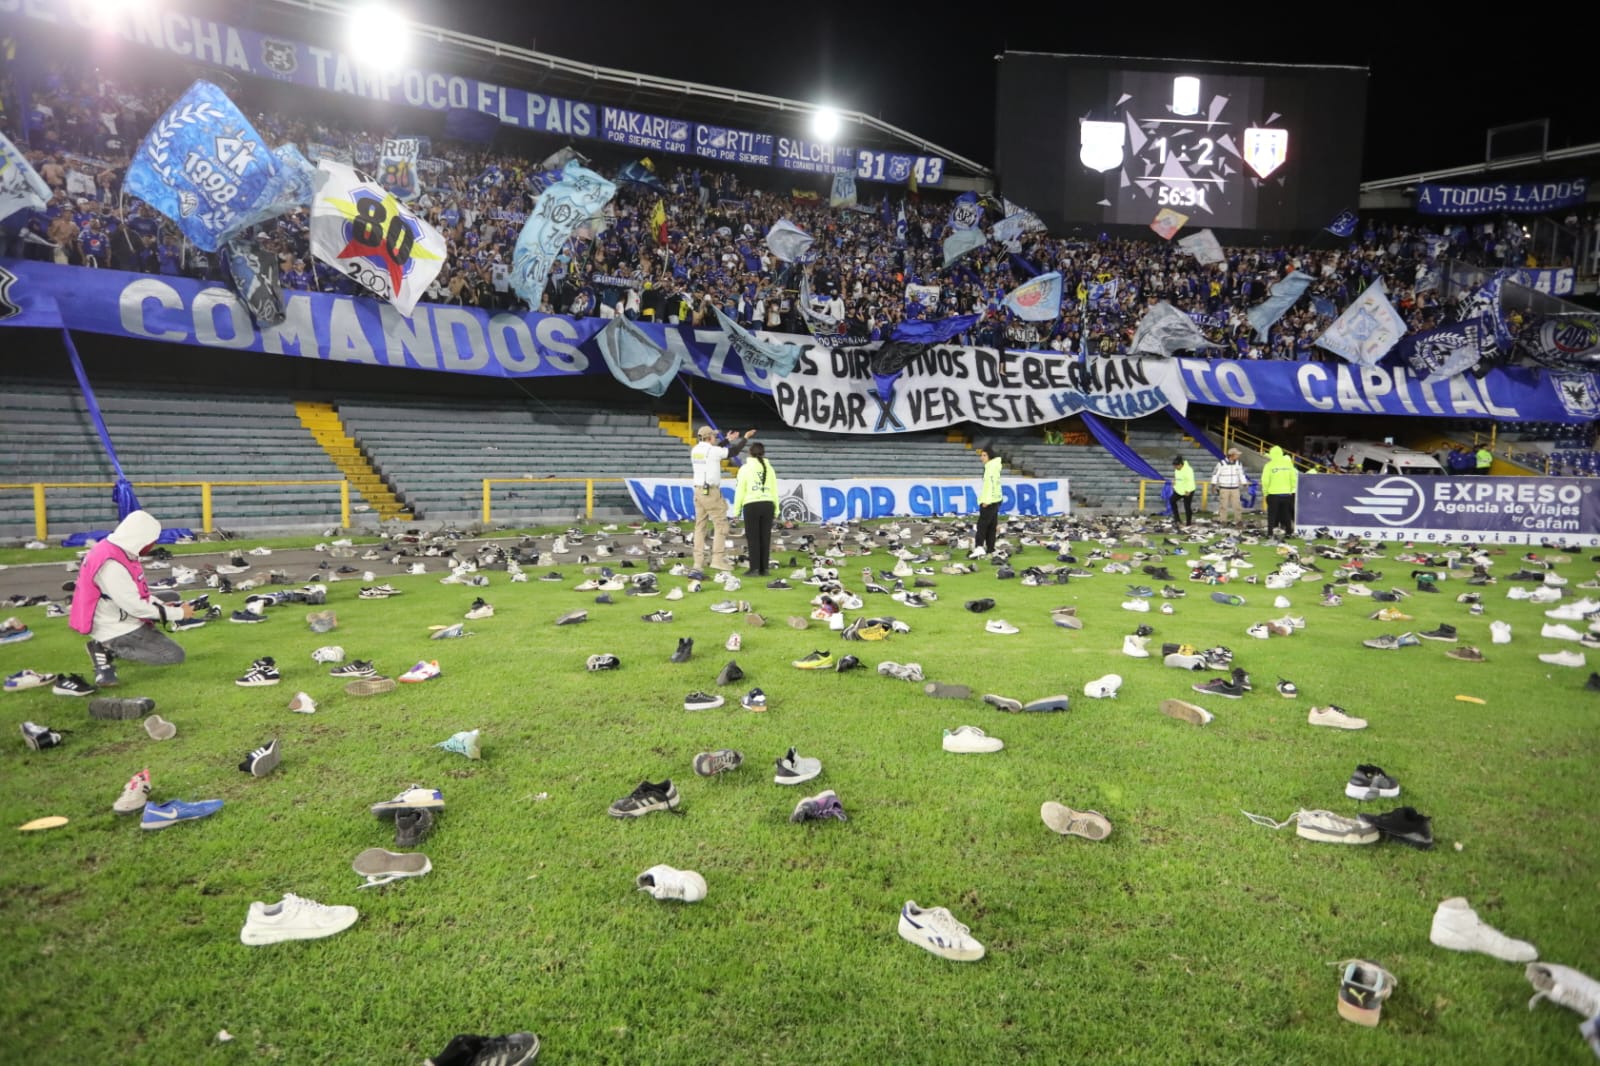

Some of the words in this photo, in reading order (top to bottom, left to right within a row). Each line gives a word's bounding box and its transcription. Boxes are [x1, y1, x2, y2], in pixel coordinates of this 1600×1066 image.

[308, 46, 468, 109] TAMPOCO
[477, 82, 519, 125] EL
[527, 93, 591, 136] PAIS
[604, 107, 669, 139] MAKARI
[608, 130, 625, 143] POR
[628, 135, 662, 149] SIEMPRE
[665, 142, 686, 152] CAPO
[696, 126, 753, 152] CRTI
[755, 134, 772, 145] PTE
[778, 137, 834, 165] SALCHI
[1155, 136, 1167, 164] 1
[1197, 137, 1214, 166] 2
[696, 146, 717, 158] CAPO
[720, 150, 735, 161] POR
[739, 151, 769, 165] SIEMPRE
[858, 151, 886, 181] 31
[184, 152, 238, 204] 1998
[913, 157, 942, 184] 43
[1157, 186, 1206, 207] 56:31
[1419, 187, 1432, 205] A
[1439, 184, 1508, 206] TODOS
[1514, 178, 1585, 202] LADOS
[352, 197, 414, 266] 80
[1534, 267, 1574, 295] 46
[119, 278, 589, 375] COMANDOS
[831, 347, 969, 379] DIRTIVOS
[1297, 363, 1521, 418] CAPITAL
[777, 382, 867, 430] PAGAR
[867, 388, 905, 433] X
[907, 387, 966, 424] VER
[968, 389, 1045, 424] ESTA
[820, 486, 895, 523] POR
[1433, 482, 1581, 504] EXPRESO
[1433, 501, 1498, 515] Agencia
[1504, 502, 1524, 514] de
[1529, 503, 1580, 517] Viajes
[1522, 516, 1579, 530] Cafam
